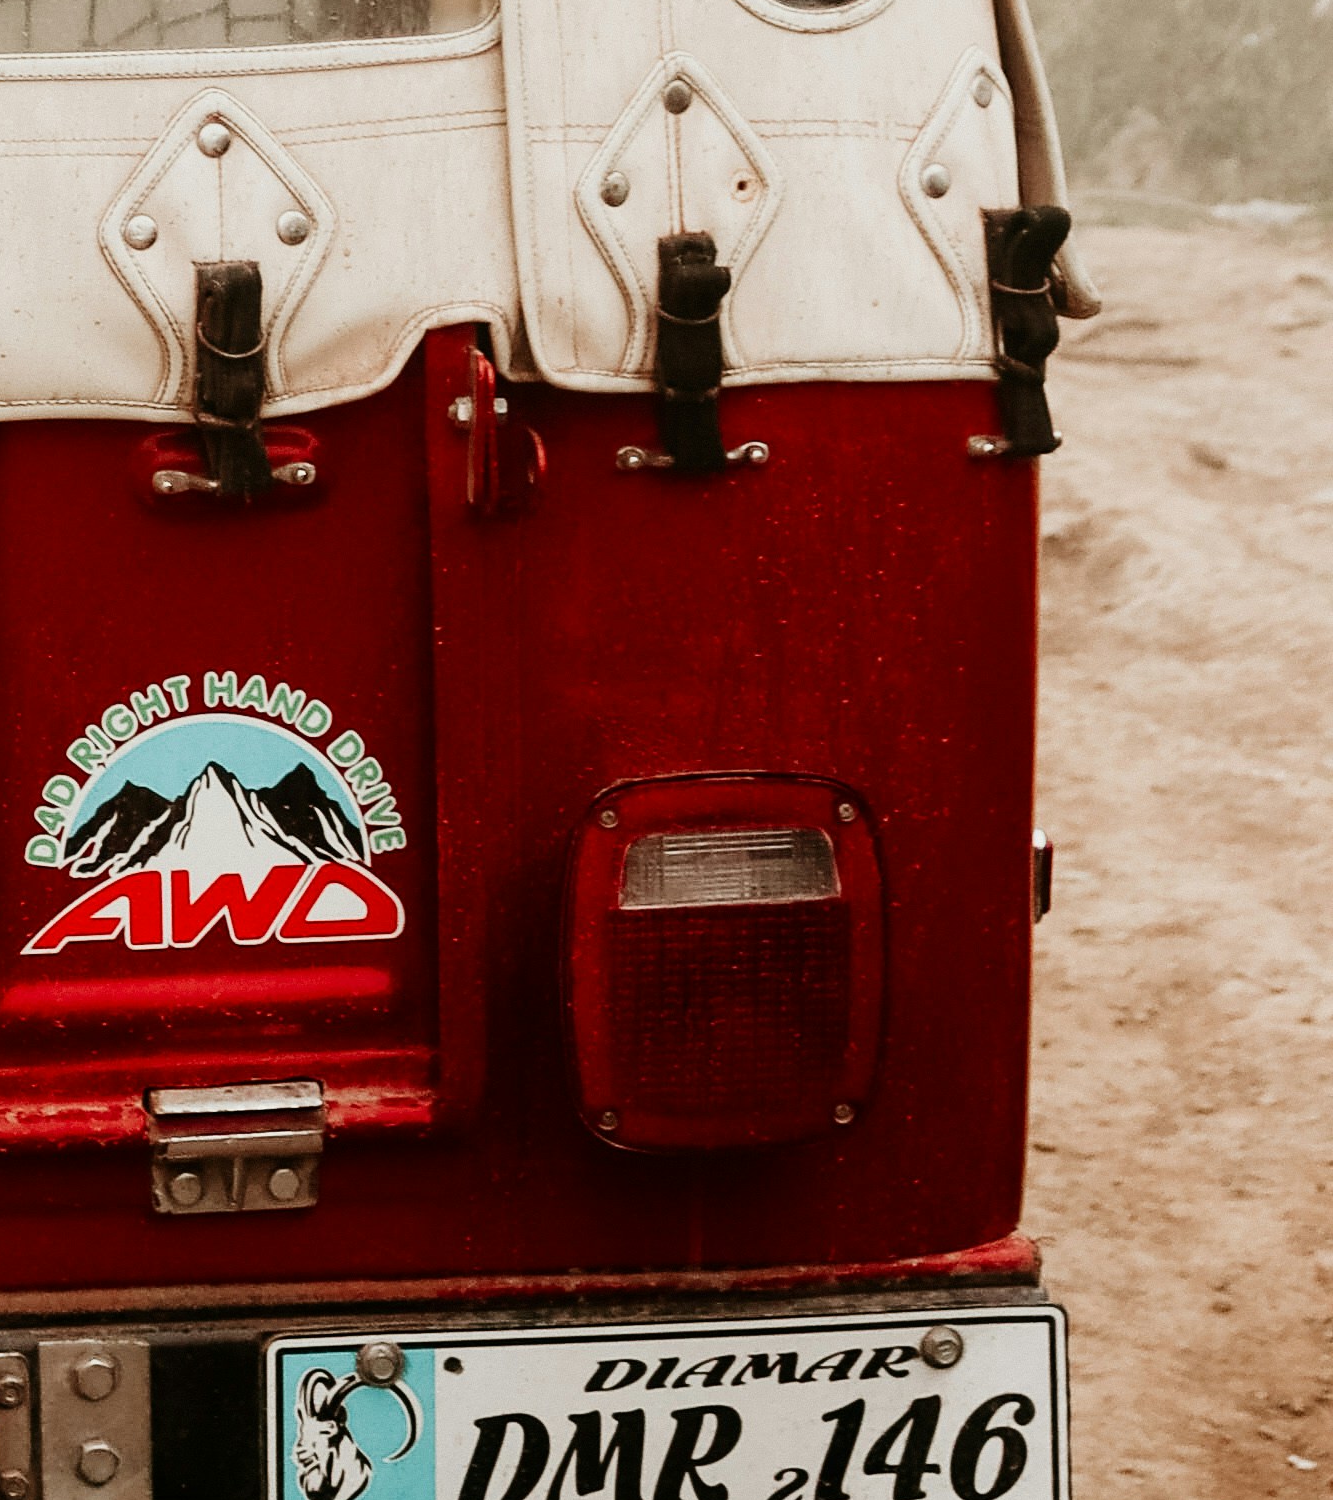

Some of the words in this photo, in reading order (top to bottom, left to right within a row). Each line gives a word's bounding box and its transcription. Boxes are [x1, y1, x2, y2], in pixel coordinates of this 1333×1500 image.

[24, 773, 83, 868] D4D
[66, 675, 192, 773] RIGHT
[203, 671, 333, 737] HAND
[326, 731, 407, 853] DRIVE
[20, 862, 405, 955] AWD
[584, 1344, 921, 1394] DIAMAR
